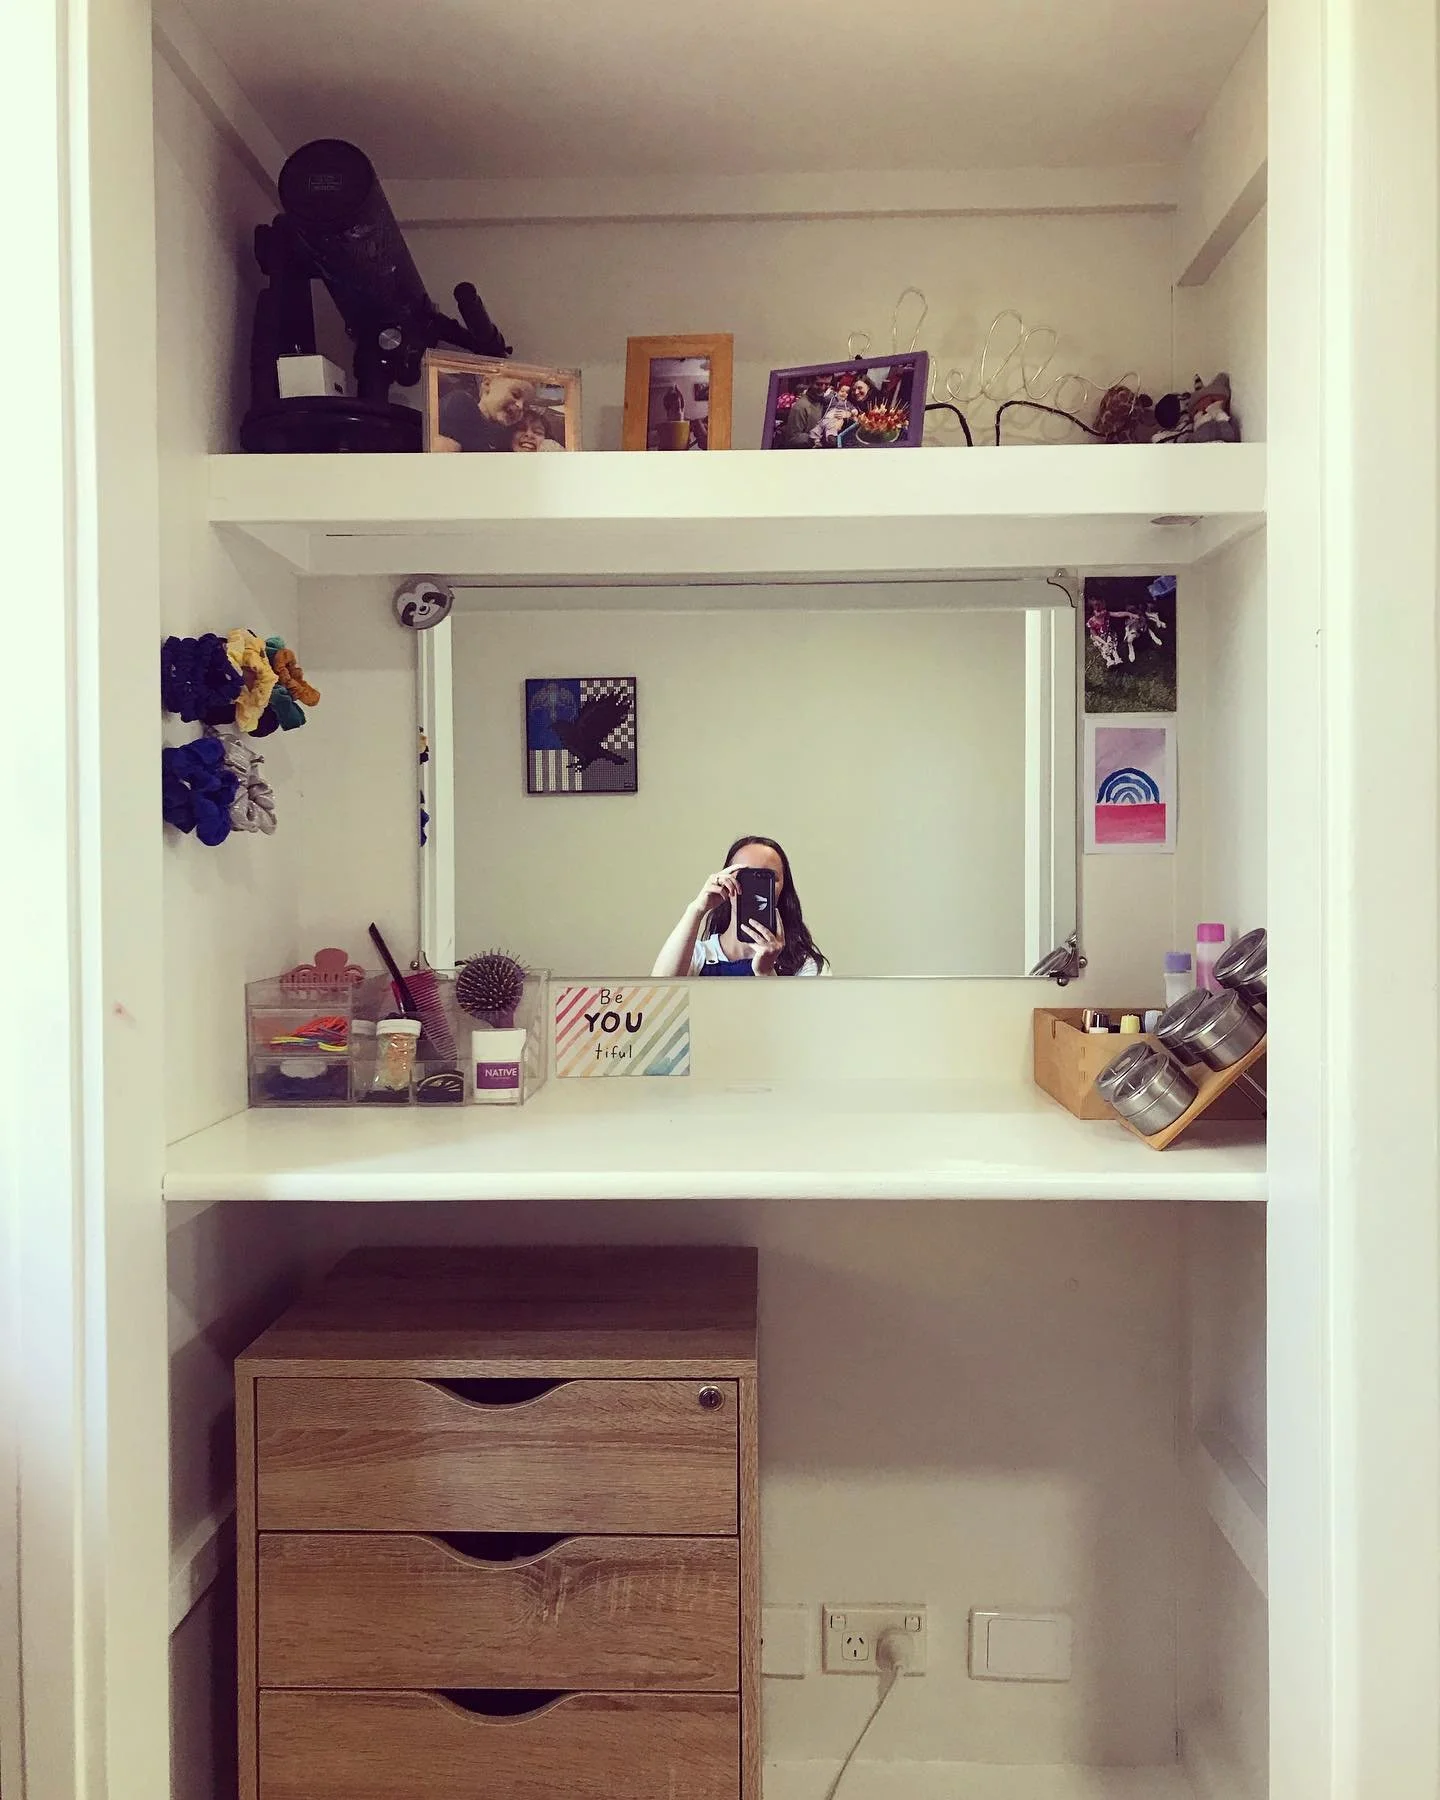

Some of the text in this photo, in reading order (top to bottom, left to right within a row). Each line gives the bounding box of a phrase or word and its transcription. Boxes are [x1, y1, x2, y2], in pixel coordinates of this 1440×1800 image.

[600, 988, 623, 1005] Be
[584, 1011, 643, 1033] YOU
[595, 1042, 632, 1060] tiful
[485, 1067, 517, 1077] NATIVE
